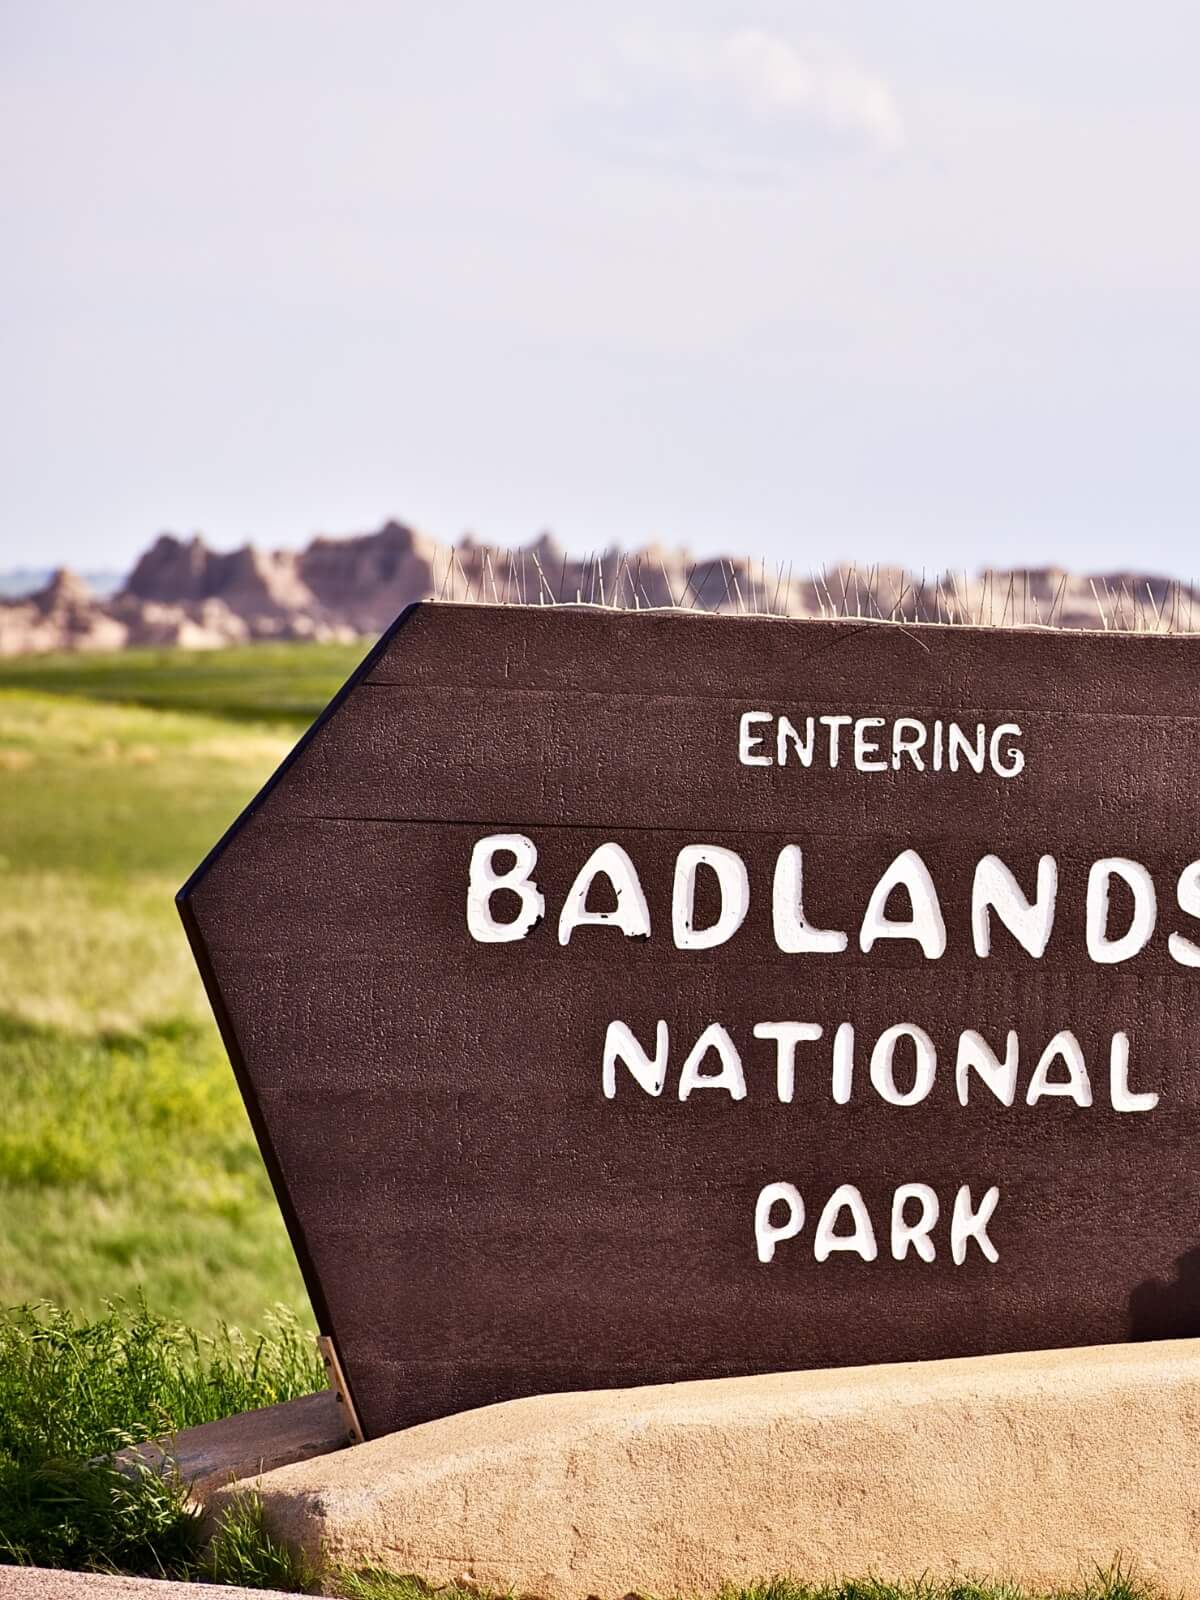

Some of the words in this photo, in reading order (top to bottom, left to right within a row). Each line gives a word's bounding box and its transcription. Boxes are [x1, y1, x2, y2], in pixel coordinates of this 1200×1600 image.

[738, 710, 1026, 778] ENTERING
[602, 1019, 1160, 1113] NATIONAL
[754, 1181, 1000, 1266] PARK
